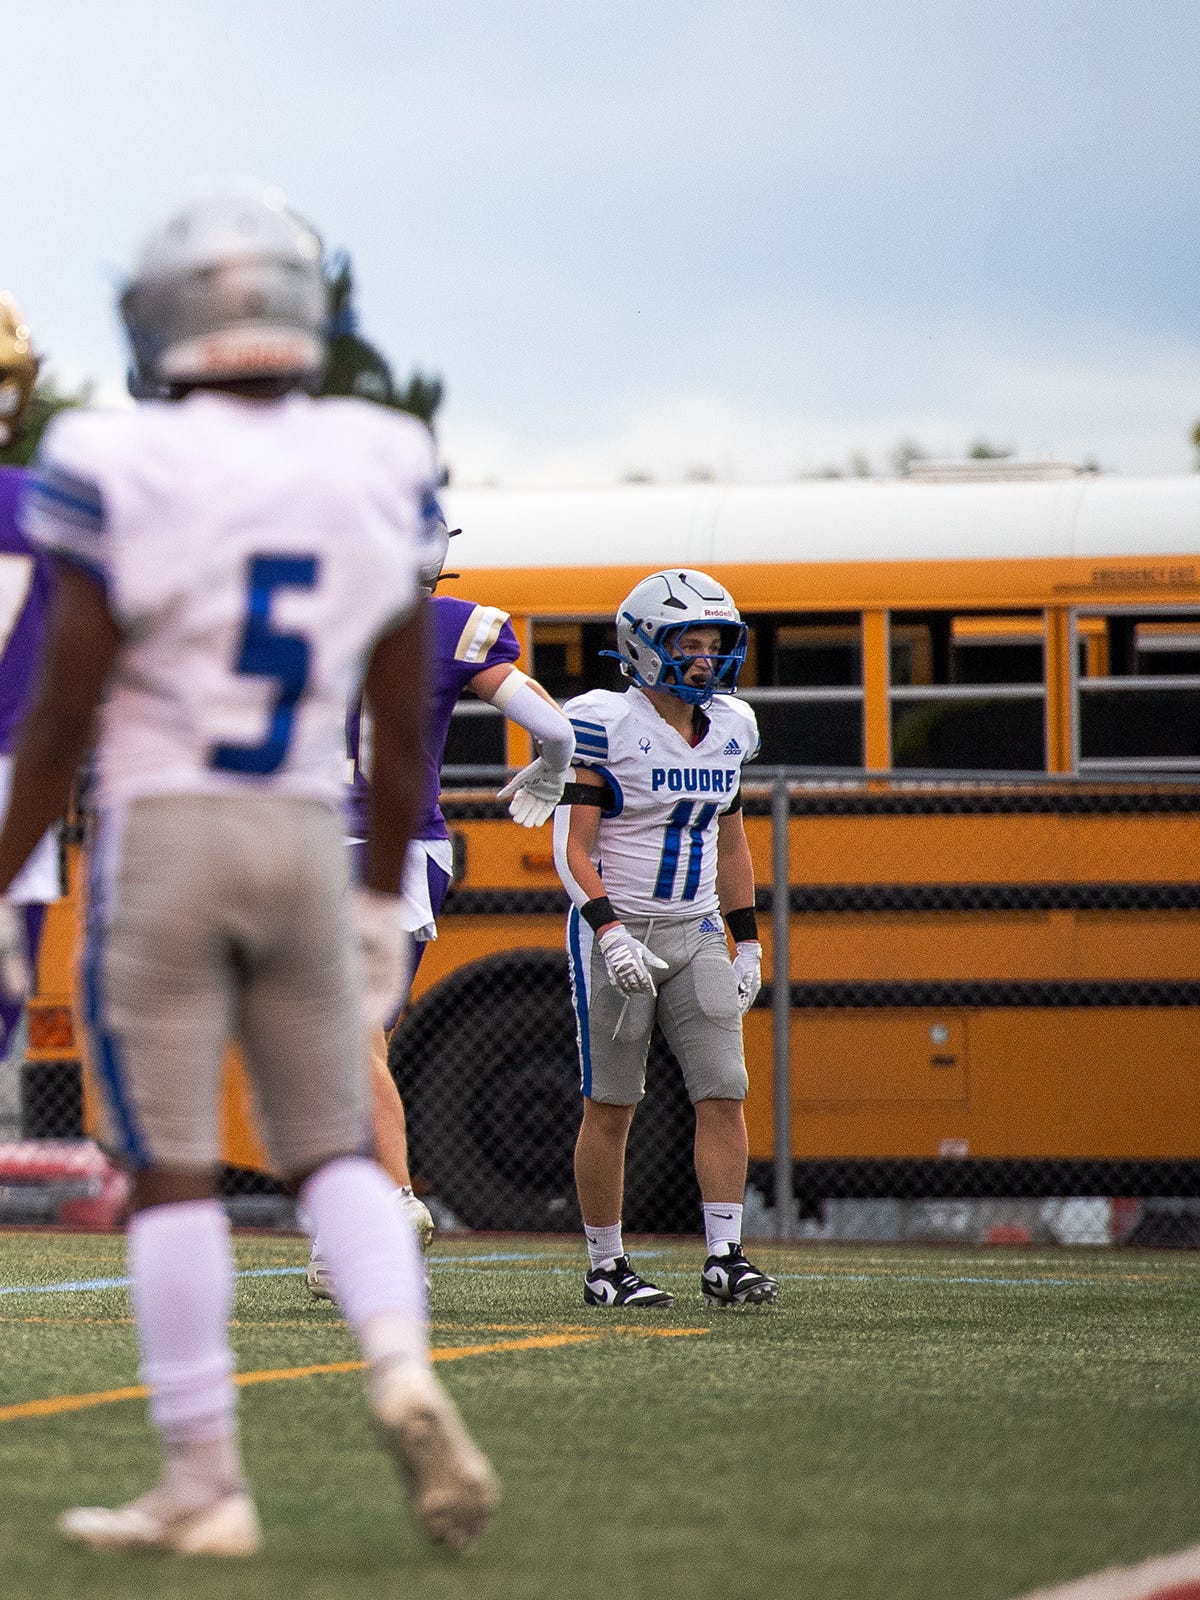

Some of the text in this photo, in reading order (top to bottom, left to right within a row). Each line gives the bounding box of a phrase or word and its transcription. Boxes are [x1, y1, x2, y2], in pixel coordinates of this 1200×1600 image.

[206, 553, 319, 775] 5
[652, 768, 736, 792] POUDRE
[652, 799, 719, 901] 11
